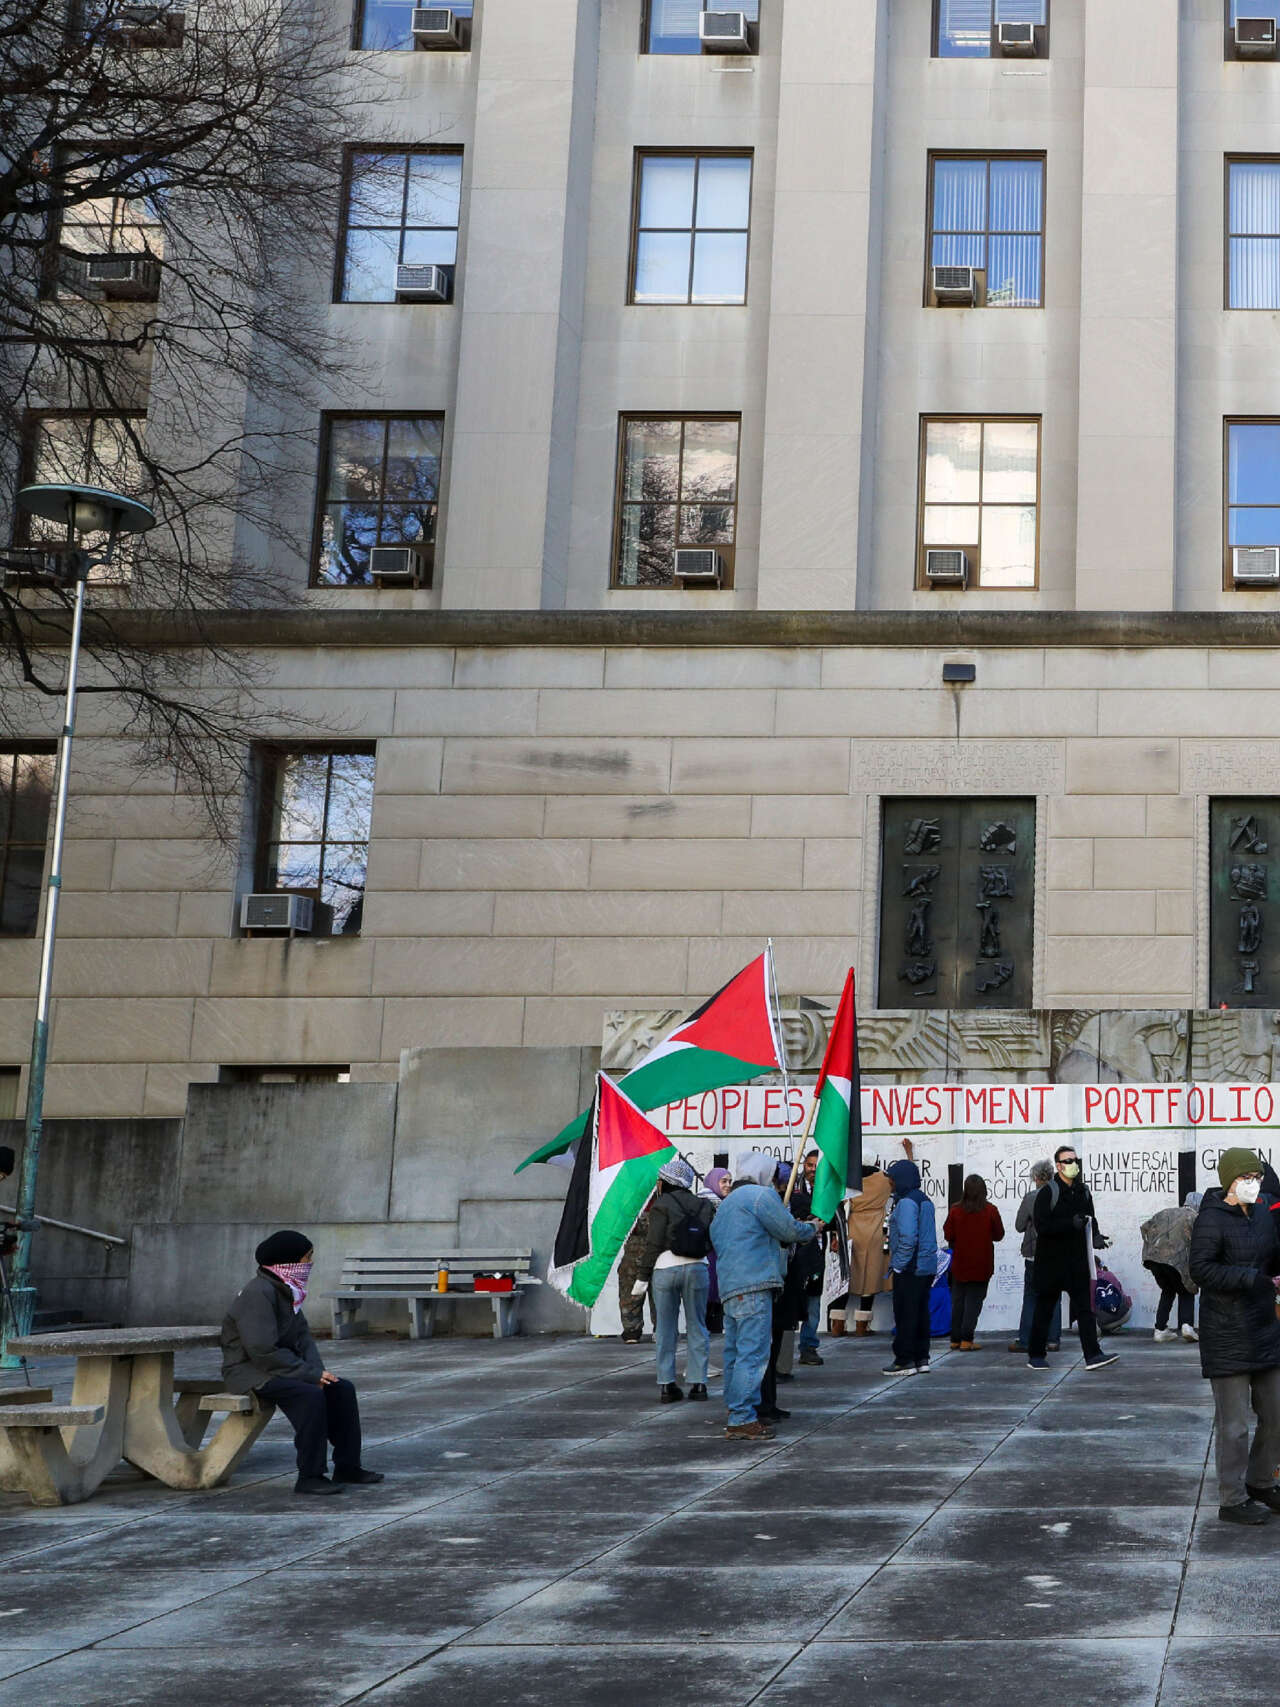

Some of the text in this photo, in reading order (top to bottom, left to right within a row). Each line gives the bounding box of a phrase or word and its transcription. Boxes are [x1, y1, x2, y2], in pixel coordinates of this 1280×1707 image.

[666, 1088, 806, 1130] PEOPLES
[1085, 1087, 1274, 1125] PORTFOLIO
[994, 1159, 1031, 1177] K-12
[1089, 1151, 1178, 1171] UNIVERSAL
[1083, 1171, 1175, 1193] HEALTHCARE
